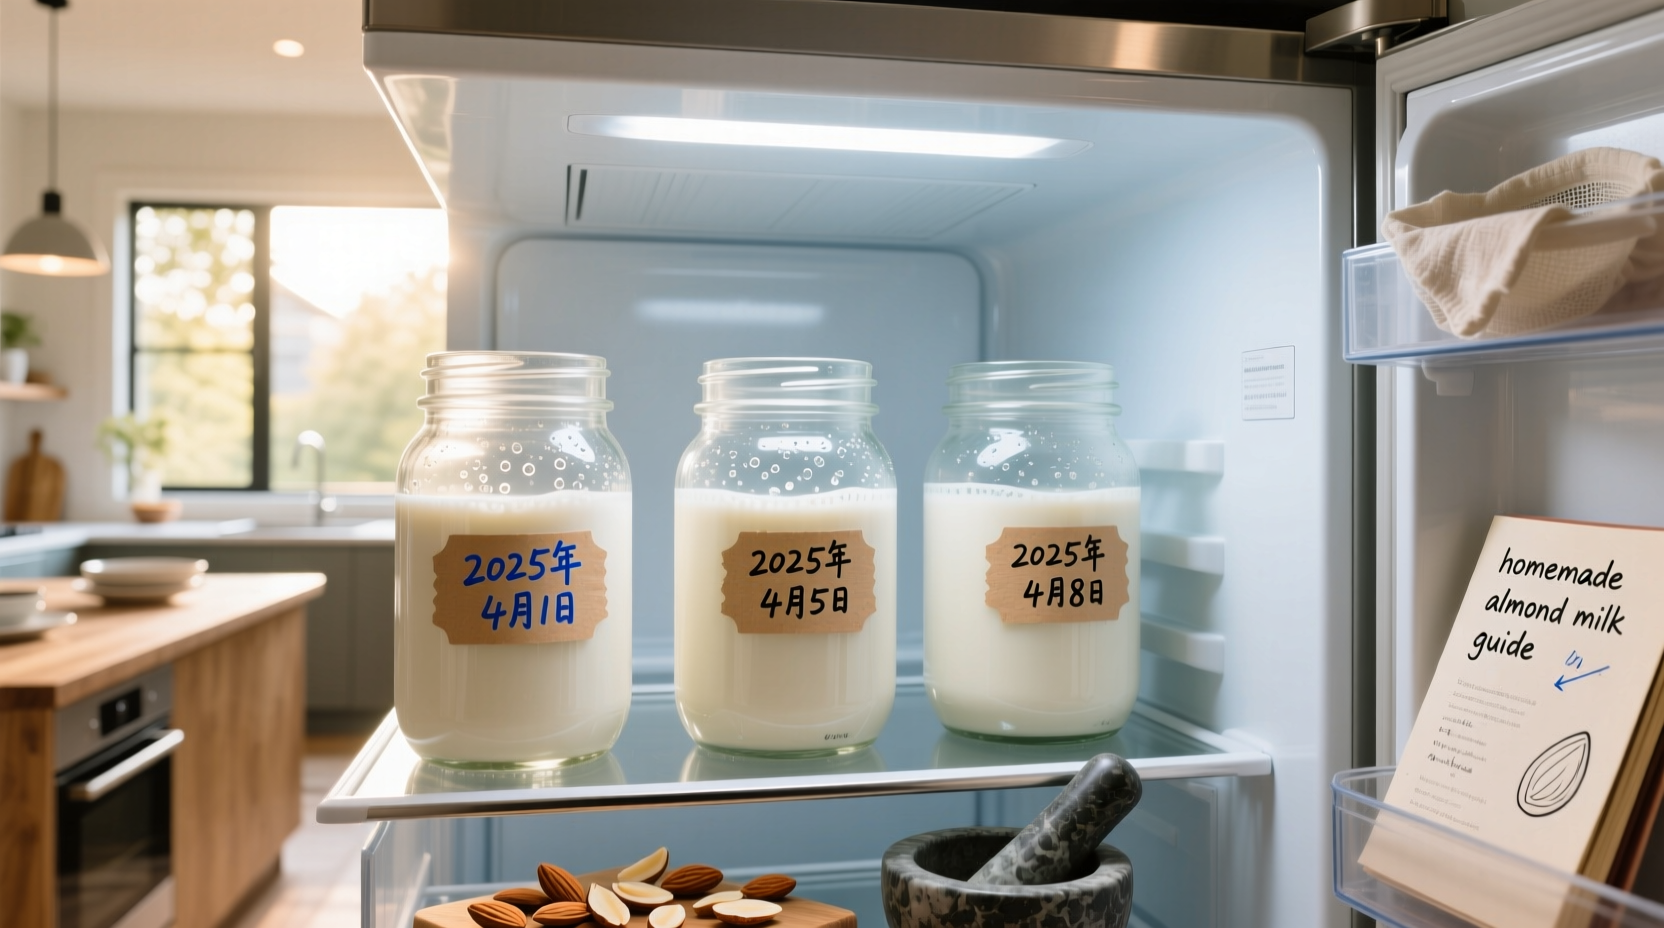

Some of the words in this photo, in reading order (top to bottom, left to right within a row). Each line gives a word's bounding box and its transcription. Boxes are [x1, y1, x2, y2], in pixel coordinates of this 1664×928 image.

[461, 540, 582, 589] 2025年
[749, 540, 852, 579] 2025年
[1010, 536, 1106, 573] 2025年
[1498, 547, 1624, 591] homemade
[480, 591, 574, 632] 4月1日
[760, 585, 848, 620] 4月5日
[1023, 577, 1104, 609] 4月8日
[1485, 588, 1569, 625] almond
[1572, 604, 1626, 636] milk
[1467, 630, 1536, 661] guide
